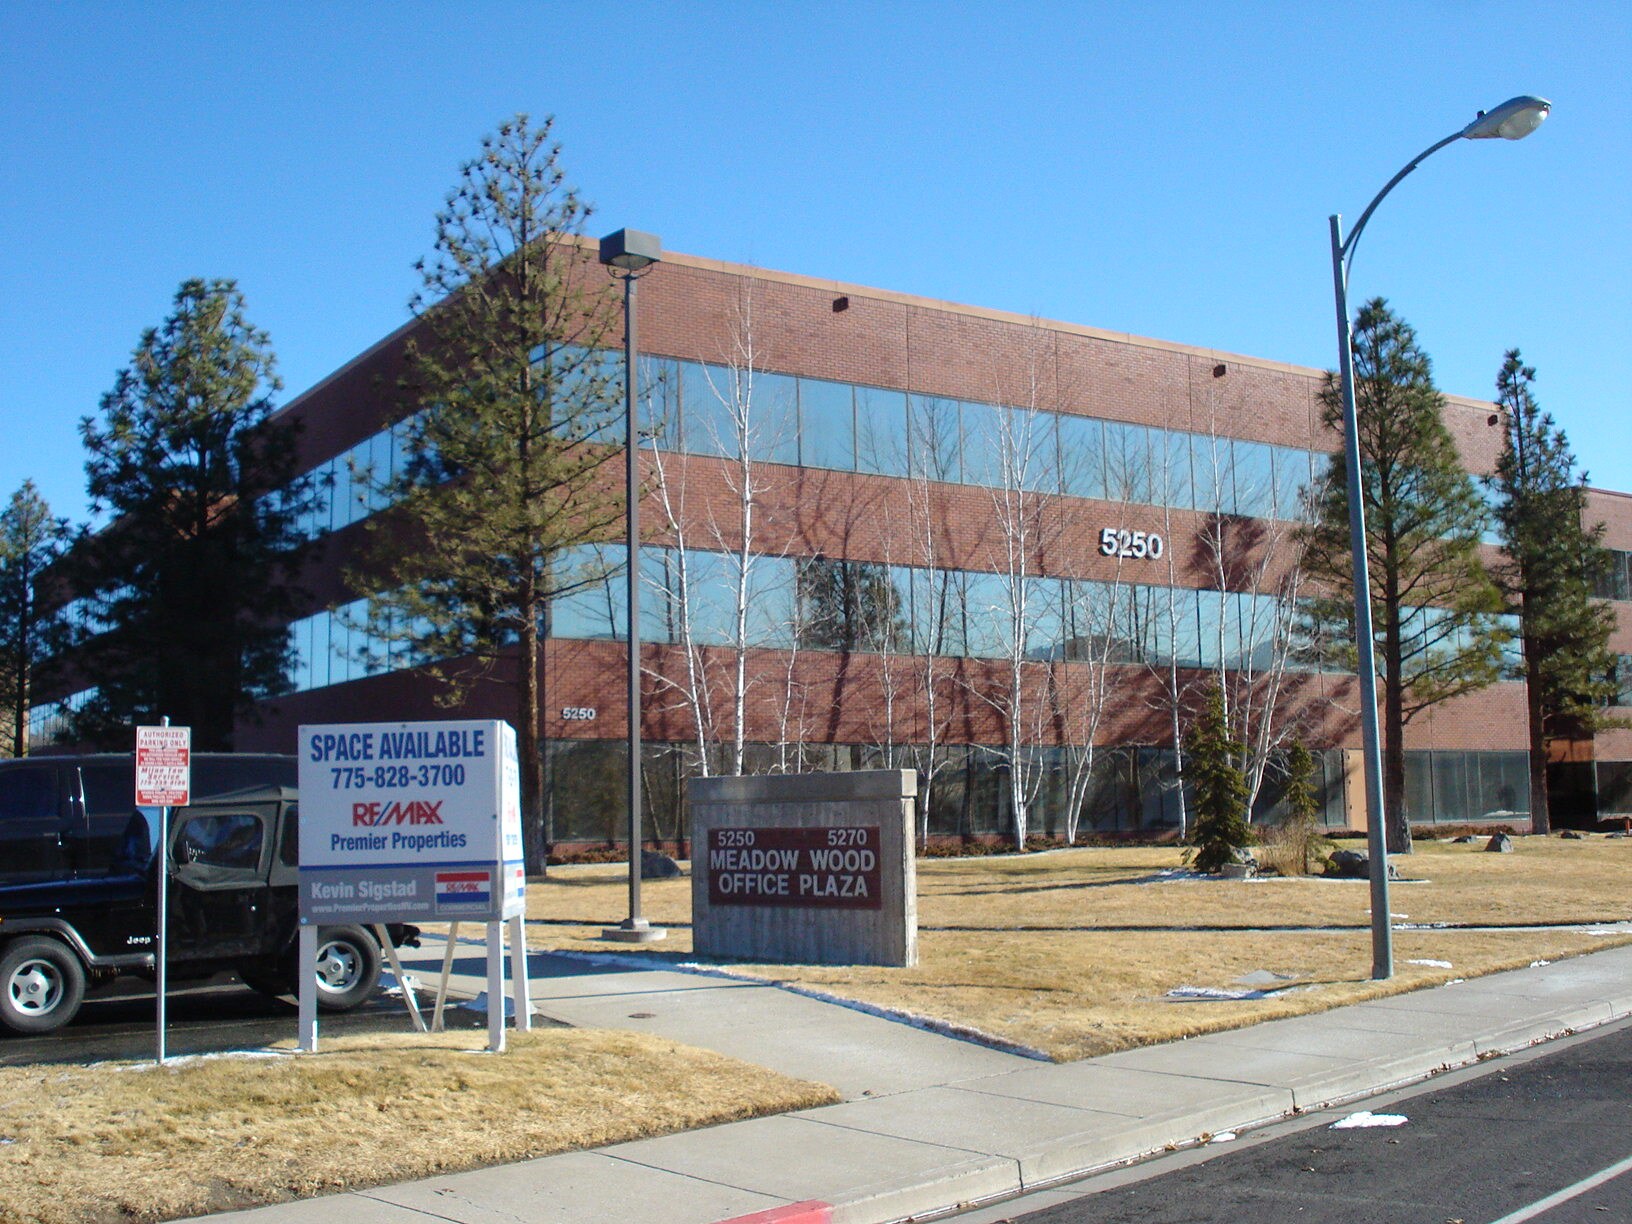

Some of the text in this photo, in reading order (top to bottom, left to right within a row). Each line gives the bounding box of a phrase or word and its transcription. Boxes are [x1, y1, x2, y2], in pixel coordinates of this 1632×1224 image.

[1101, 528, 1164, 560] 5250
[562, 707, 597, 720] 5250
[140, 739, 187, 747] PARKING ONLY
[310, 733, 374, 762] SPACE
[378, 730, 485, 760] AVAILABLE
[330, 764, 466, 789] 775-828-3700
[352, 800, 444, 826] RE/MAX
[331, 830, 467, 852] Premier Properties
[718, 829, 868, 846] 5250 5270
[710, 849, 876, 872] MEADOW WOOD
[311, 880, 417, 900] Kevin Sigstad
[718, 873, 868, 898] OFFICE PLAZA
[126, 935, 151, 945] Jeep
